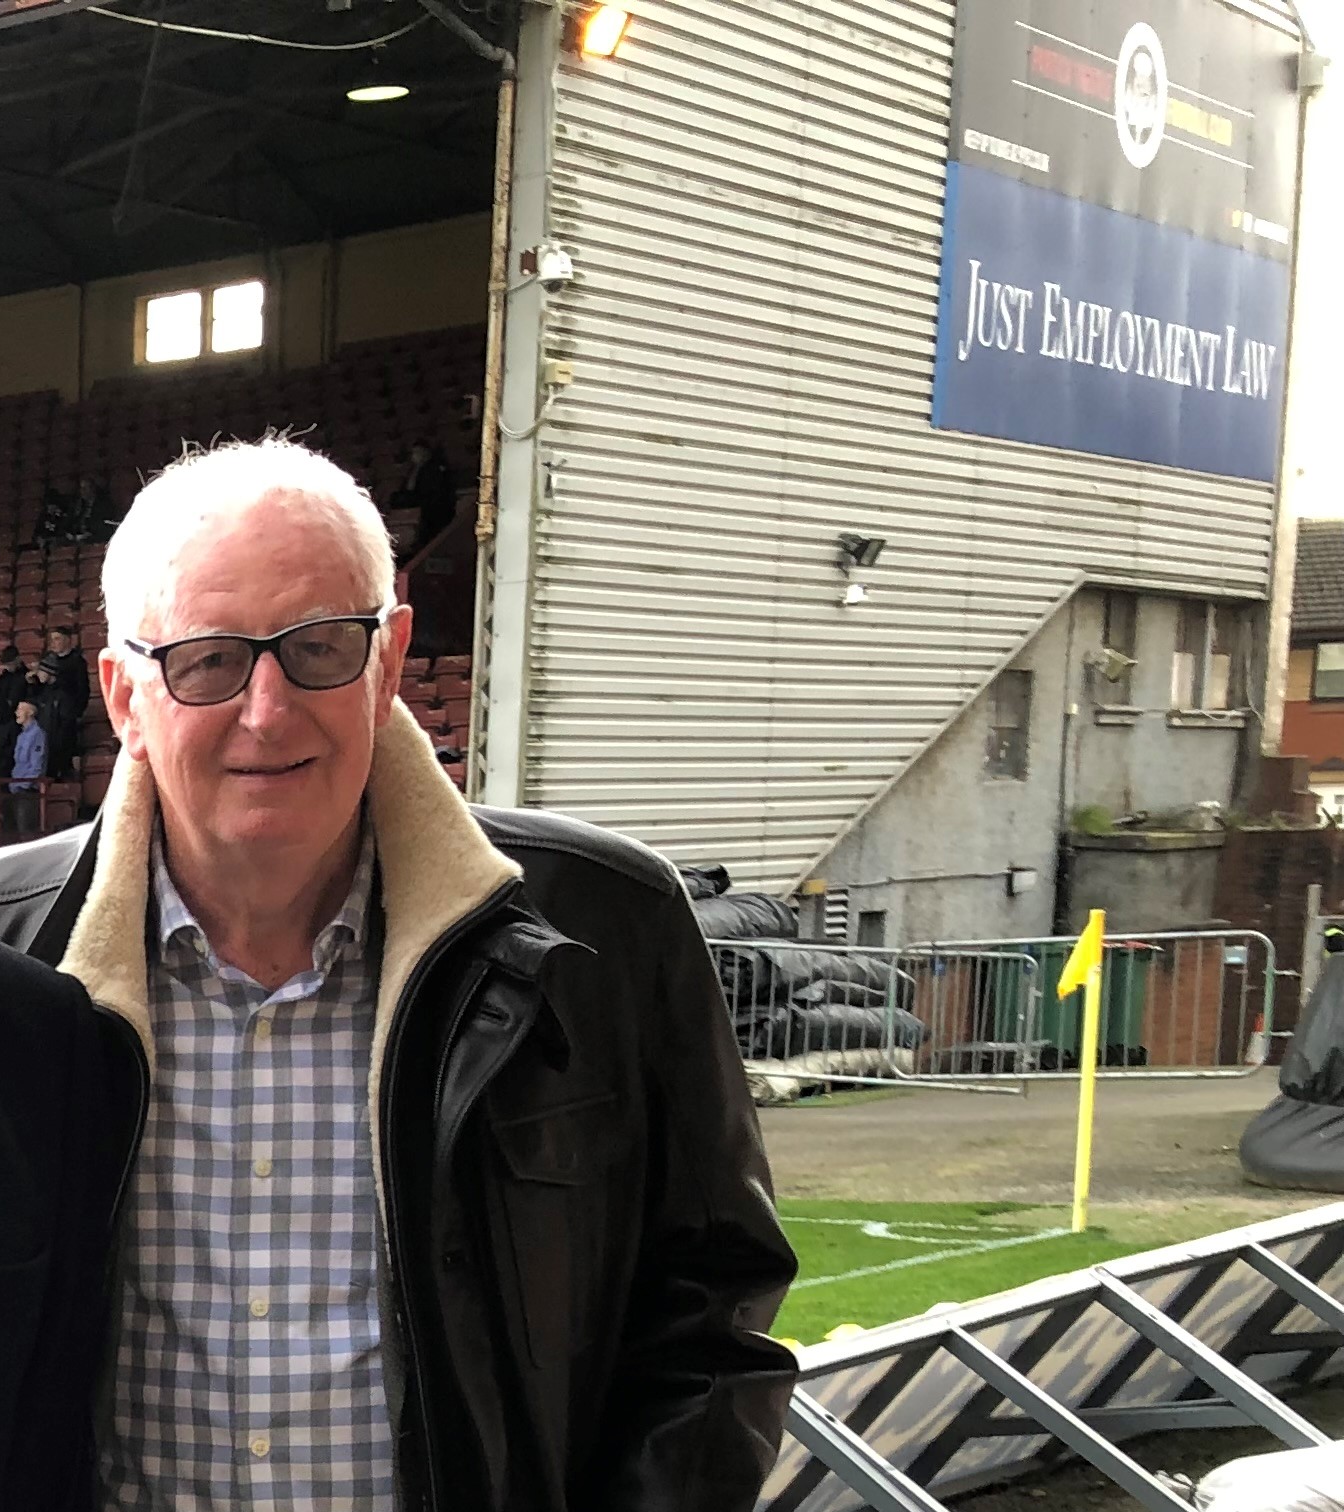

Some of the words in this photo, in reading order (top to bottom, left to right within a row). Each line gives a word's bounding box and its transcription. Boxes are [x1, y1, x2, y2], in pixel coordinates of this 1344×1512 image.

[958, 259, 1033, 361] JUST
[1039, 281, 1221, 393] EMPLOYMENT
[1221, 325, 1277, 400] LAW
